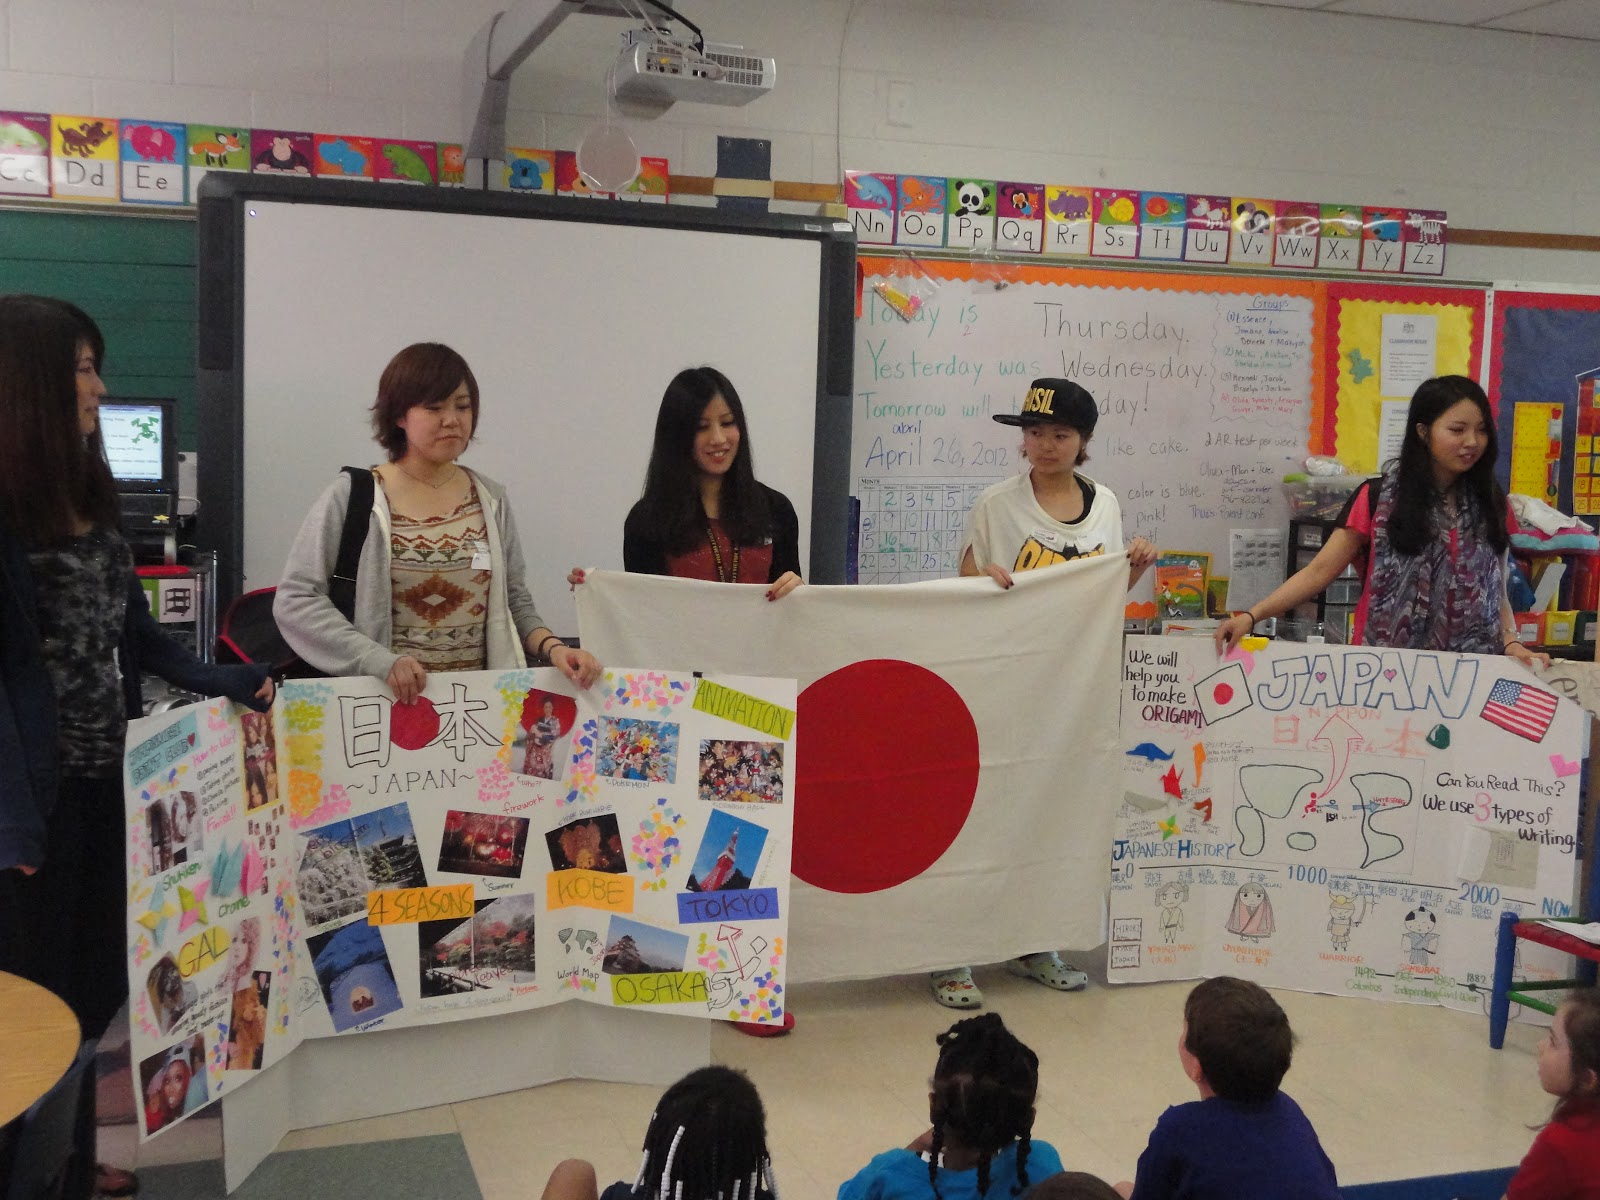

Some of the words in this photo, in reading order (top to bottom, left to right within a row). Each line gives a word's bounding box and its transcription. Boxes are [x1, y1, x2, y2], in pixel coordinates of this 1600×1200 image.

[67, 161, 104, 187] Dd
[137, 165, 168, 190] Ee
[855, 211, 884, 233] Nn
[904, 215, 936, 236] Oo
[958, 218, 983, 243] Pp
[1001, 221, 1035, 251] Qq
[1057, 224, 1078, 244] Rr
[1104, 226, 1124, 246] Ss
[1152, 229, 1171, 249] Tt
[1195, 234, 1219, 253] Uu
[1240, 235, 1264, 254] Vv
[1279, 237, 1313, 258] Ww
[1327, 241, 1349, 260] Xx
[1372, 243, 1393, 270] Yy
[1413, 245, 1434, 265] Zz
[862, 290, 940, 338] Toay
[959, 299, 978, 324] is
[1034, 302, 1190, 356] Thursday.
[867, 339, 983, 386] Yesterday
[999, 359, 1041, 378] was
[1062, 350, 1208, 388] Wednesday.
[858, 392, 946, 419] Tomorrow
[962, 394, 991, 418] will
[893, 420, 922, 434] abril
[865, 436, 922, 470] April
[971, 441, 1009, 467] 2012
[1106, 437, 1136, 456] like
[1150, 436, 1188, 454] cake.
[885, 492, 897, 506] 2
[906, 492, 916, 507] 3
[925, 492, 934, 506] 4
[947, 490, 961, 507] 5
[1127, 482, 1154, 499] color
[1161, 483, 1170, 497] is
[904, 512, 918, 530] 10
[926, 512, 936, 530] 11
[945, 511, 961, 529] 12
[1136, 505, 1166, 528] pink!
[861, 533, 875, 549] 15
[885, 532, 897, 545] 16
[927, 532, 940, 550] 18
[860, 553, 875, 570] 22
[903, 553, 918, 570] 24
[922, 553, 938, 569] 25
[1129, 649, 1154, 664] We
[1157, 651, 1178, 668] will
[1125, 665, 1153, 688] help
[1156, 673, 1180, 687] you
[1257, 652, 1479, 719] JAPAN
[1131, 686, 1146, 702] to
[1148, 685, 1187, 704] make
[694, 679, 788, 736] ANIMATION
[1141, 704, 1202, 729] ORIGAMI
[1436, 772, 1462, 788] Can
[1486, 773, 1519, 792] Read
[1522, 777, 1565, 798] This?
[503, 794, 545, 815] firework
[1423, 793, 1449, 812] We
[1450, 799, 1475, 815] use
[1474, 792, 1492, 822] 3
[1491, 801, 1535, 826] types
[1537, 806, 1553, 824] of
[1113, 839, 1177, 861] JAPANESE
[1178, 839, 1236, 860] HISTORY
[1517, 828, 1577, 853] Writing.
[557, 876, 625, 905] KOBE
[1125, 862, 1134, 879] 0
[1288, 864, 1328, 885] 1000
[1459, 882, 1500, 906] 2000
[218, 896, 250, 918] Crane
[368, 893, 389, 923] 4
[393, 885, 473, 921] SEASONS
[687, 893, 769, 921] TOKYO
[179, 926, 229, 977] GAL
[1318, 952, 1365, 964] WARRIOR
[557, 966, 579, 980] World
[582, 968, 600, 982] Map
[1399, 964, 1441, 975] SAMURAI
[615, 972, 708, 1003] OSAKA
